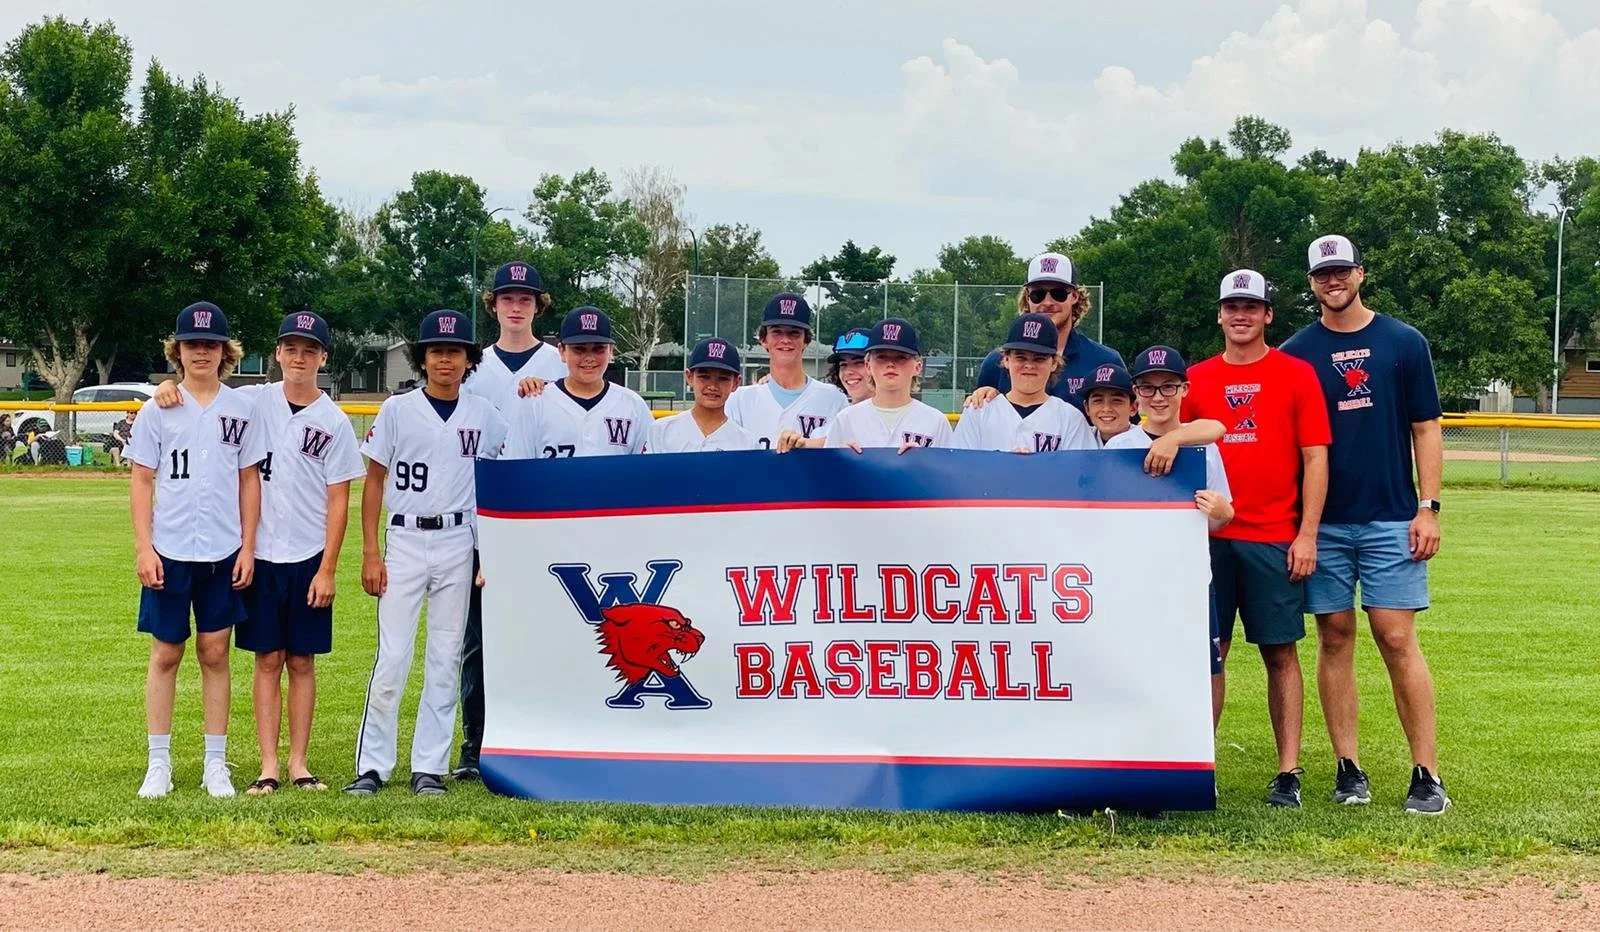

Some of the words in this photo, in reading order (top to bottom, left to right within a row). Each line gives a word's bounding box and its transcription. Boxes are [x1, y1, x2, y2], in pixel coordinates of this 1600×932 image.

[510, 265, 528, 281] W
[1040, 257, 1059, 274] W
[780, 299, 797, 315] W
[193, 311, 212, 329] W
[296, 315, 315, 331] W
[438, 316, 457, 334] W
[580, 313, 598, 331] W
[883, 324, 902, 341] W
[1023, 321, 1042, 339] W
[708, 342, 726, 359] W
[1148, 350, 1167, 366] W
[1095, 367, 1114, 382] W
[1067, 378, 1085, 394] W
[218, 415, 249, 448] W
[603, 416, 632, 447] W
[299, 424, 335, 461] W
[457, 428, 482, 458] W
[170, 448, 190, 480] 11
[259, 451, 273, 482] 4
[395, 460, 429, 493] 99
[725, 563, 1093, 626] WILDCATS
[733, 639, 1073, 701] BASEBALL
